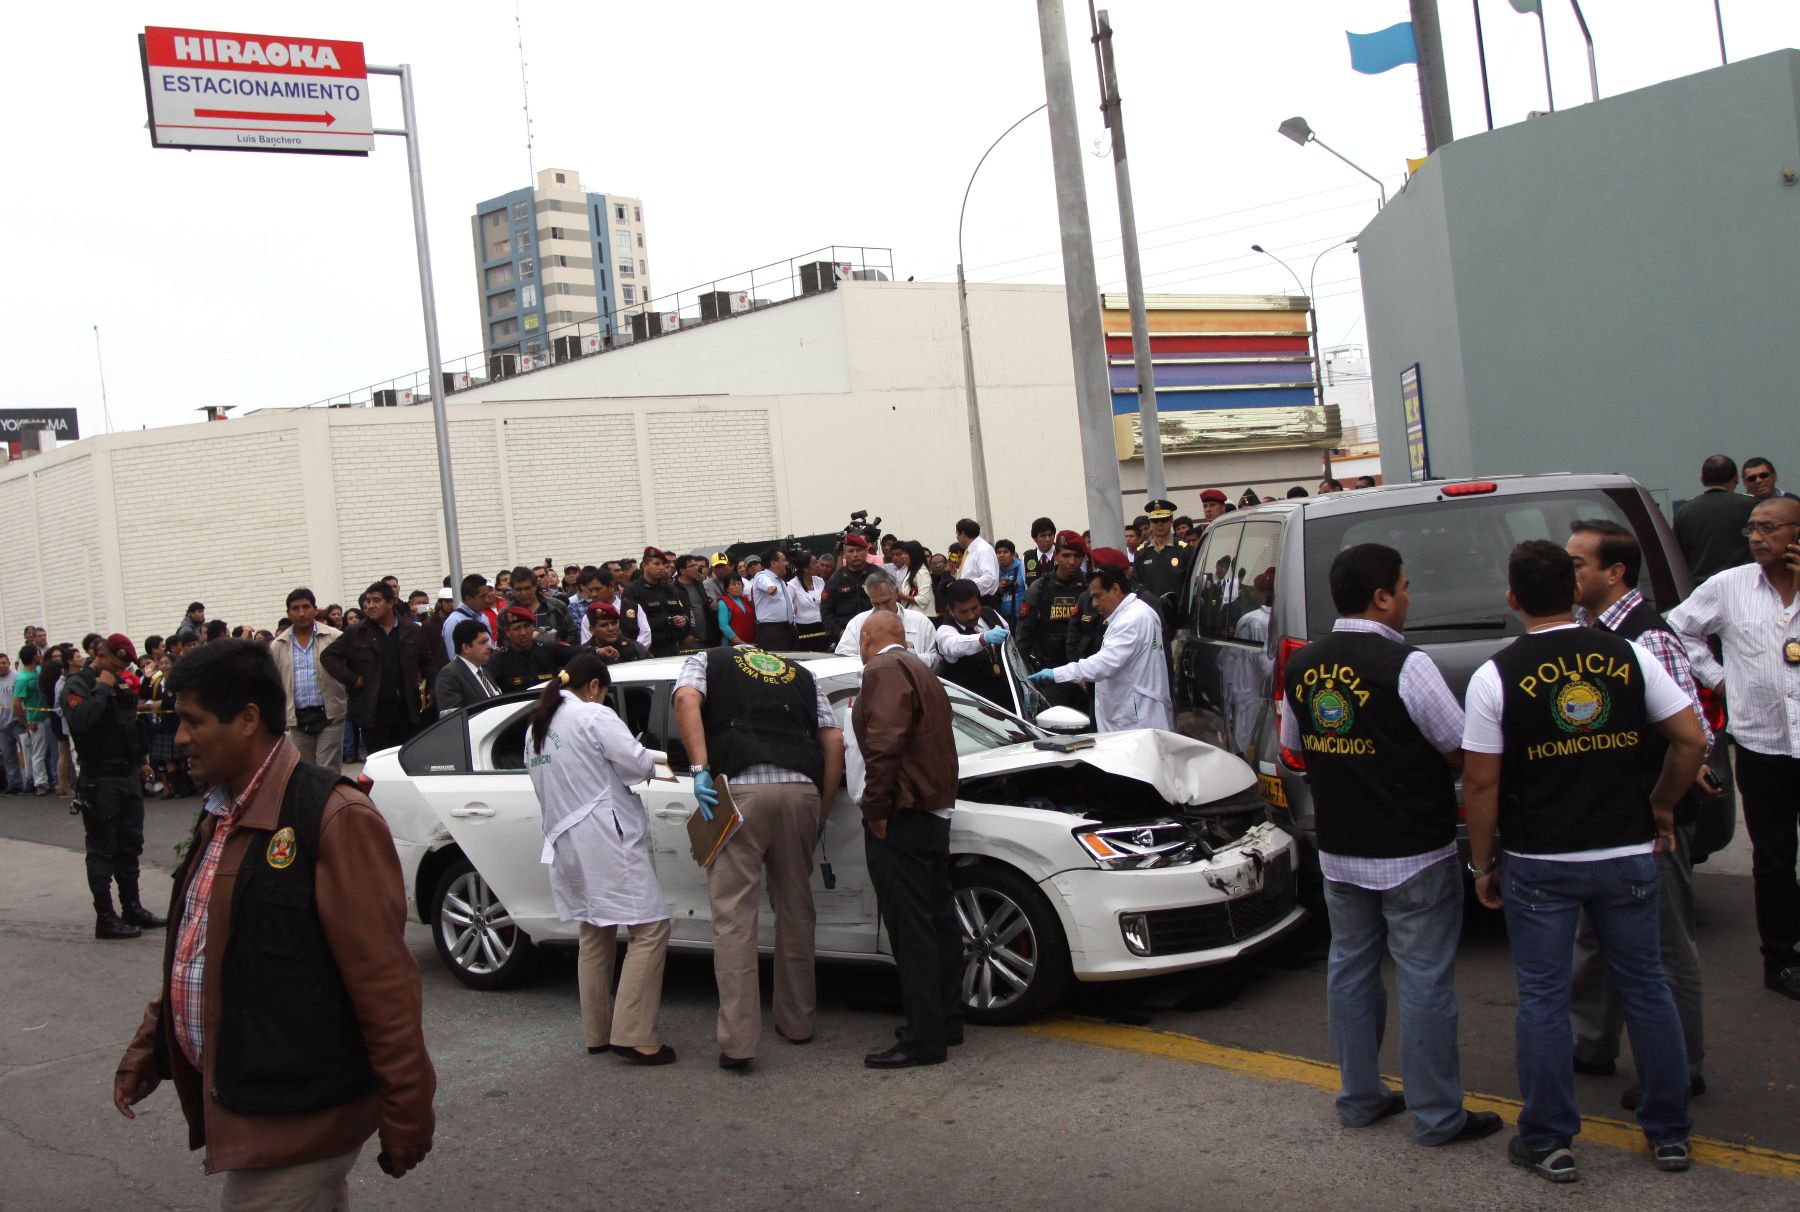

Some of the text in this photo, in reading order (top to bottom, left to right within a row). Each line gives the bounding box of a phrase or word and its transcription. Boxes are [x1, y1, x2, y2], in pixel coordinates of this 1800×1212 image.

[173, 36, 341, 70] HIRAOKA
[162, 75, 360, 101] ESTACIONAMIENTO
[237, 134, 302, 145] Luis Banchero
[0, 418, 68, 431] YOKMA
[733, 655, 759, 679] ESCENA
[763, 676, 780, 685] DEL
[1519, 653, 1631, 698] POLICIA
[1295, 663, 1370, 708] POLICIA
[1302, 735, 1376, 755] HOMICIDIOS
[1527, 731, 1639, 760] HOMICIDIOS
